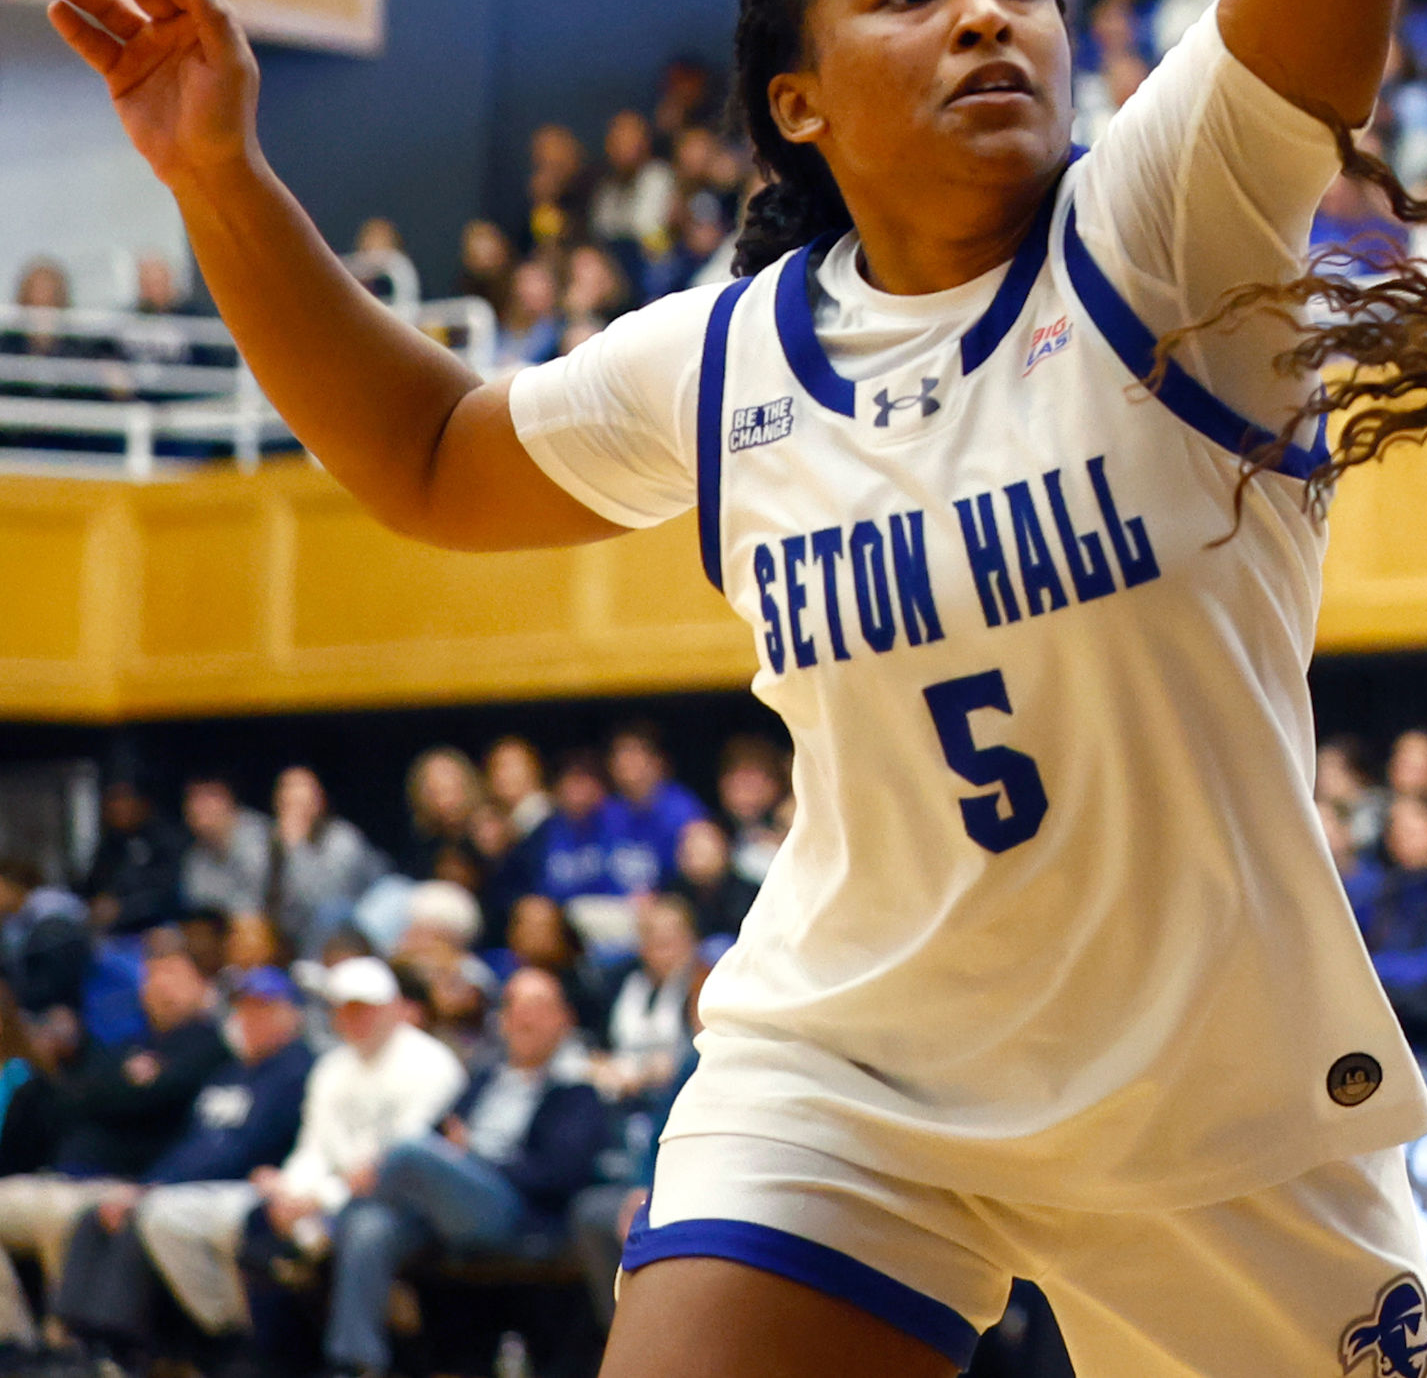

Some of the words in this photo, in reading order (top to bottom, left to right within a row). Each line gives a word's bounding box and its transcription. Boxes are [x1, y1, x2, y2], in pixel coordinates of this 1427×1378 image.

[728, 415, 794, 454] CHANGE
[733, 408, 759, 430] BE
[762, 396, 793, 425] THE
[754, 510, 946, 675] SETON
[953, 455, 1161, 628] HALL
[922, 669, 1049, 854] 5
